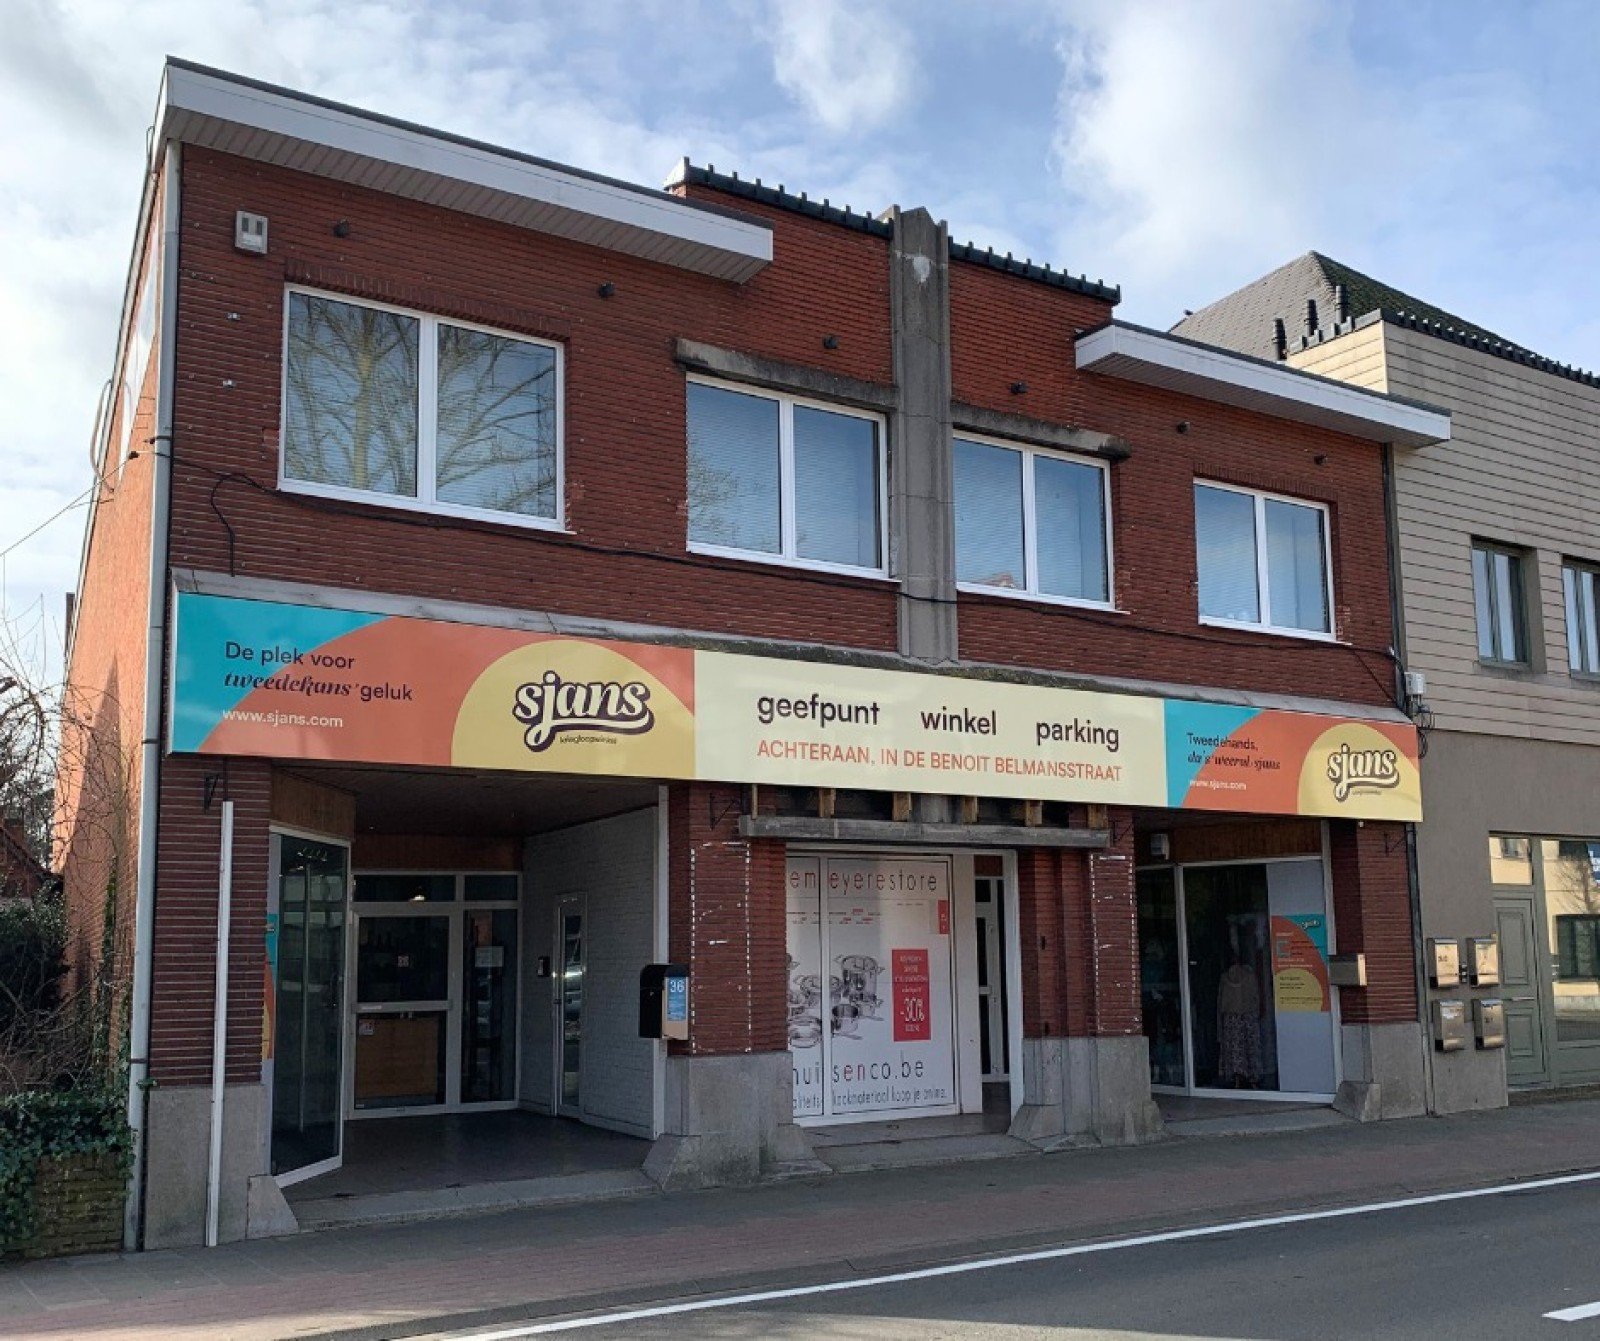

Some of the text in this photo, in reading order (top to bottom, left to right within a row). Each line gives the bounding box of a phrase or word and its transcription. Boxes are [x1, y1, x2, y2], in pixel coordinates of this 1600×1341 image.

[225, 641, 355, 669] De plek voor
[222, 709, 343, 728] www.sjans.com
[512, 670, 655, 753] sjans
[757, 692, 1119, 753] geefpunt winkel parking
[1186, 732, 1259, 751] Tweedehands,
[881, 748, 898, 766] IN
[903, 750, 925, 768] DE
[930, 752, 990, 772] BENOIT
[995, 757, 1122, 782] BELMANSSTRAAT
[1328, 743, 1400, 803] sjans
[669, 979, 685, 993] 36
